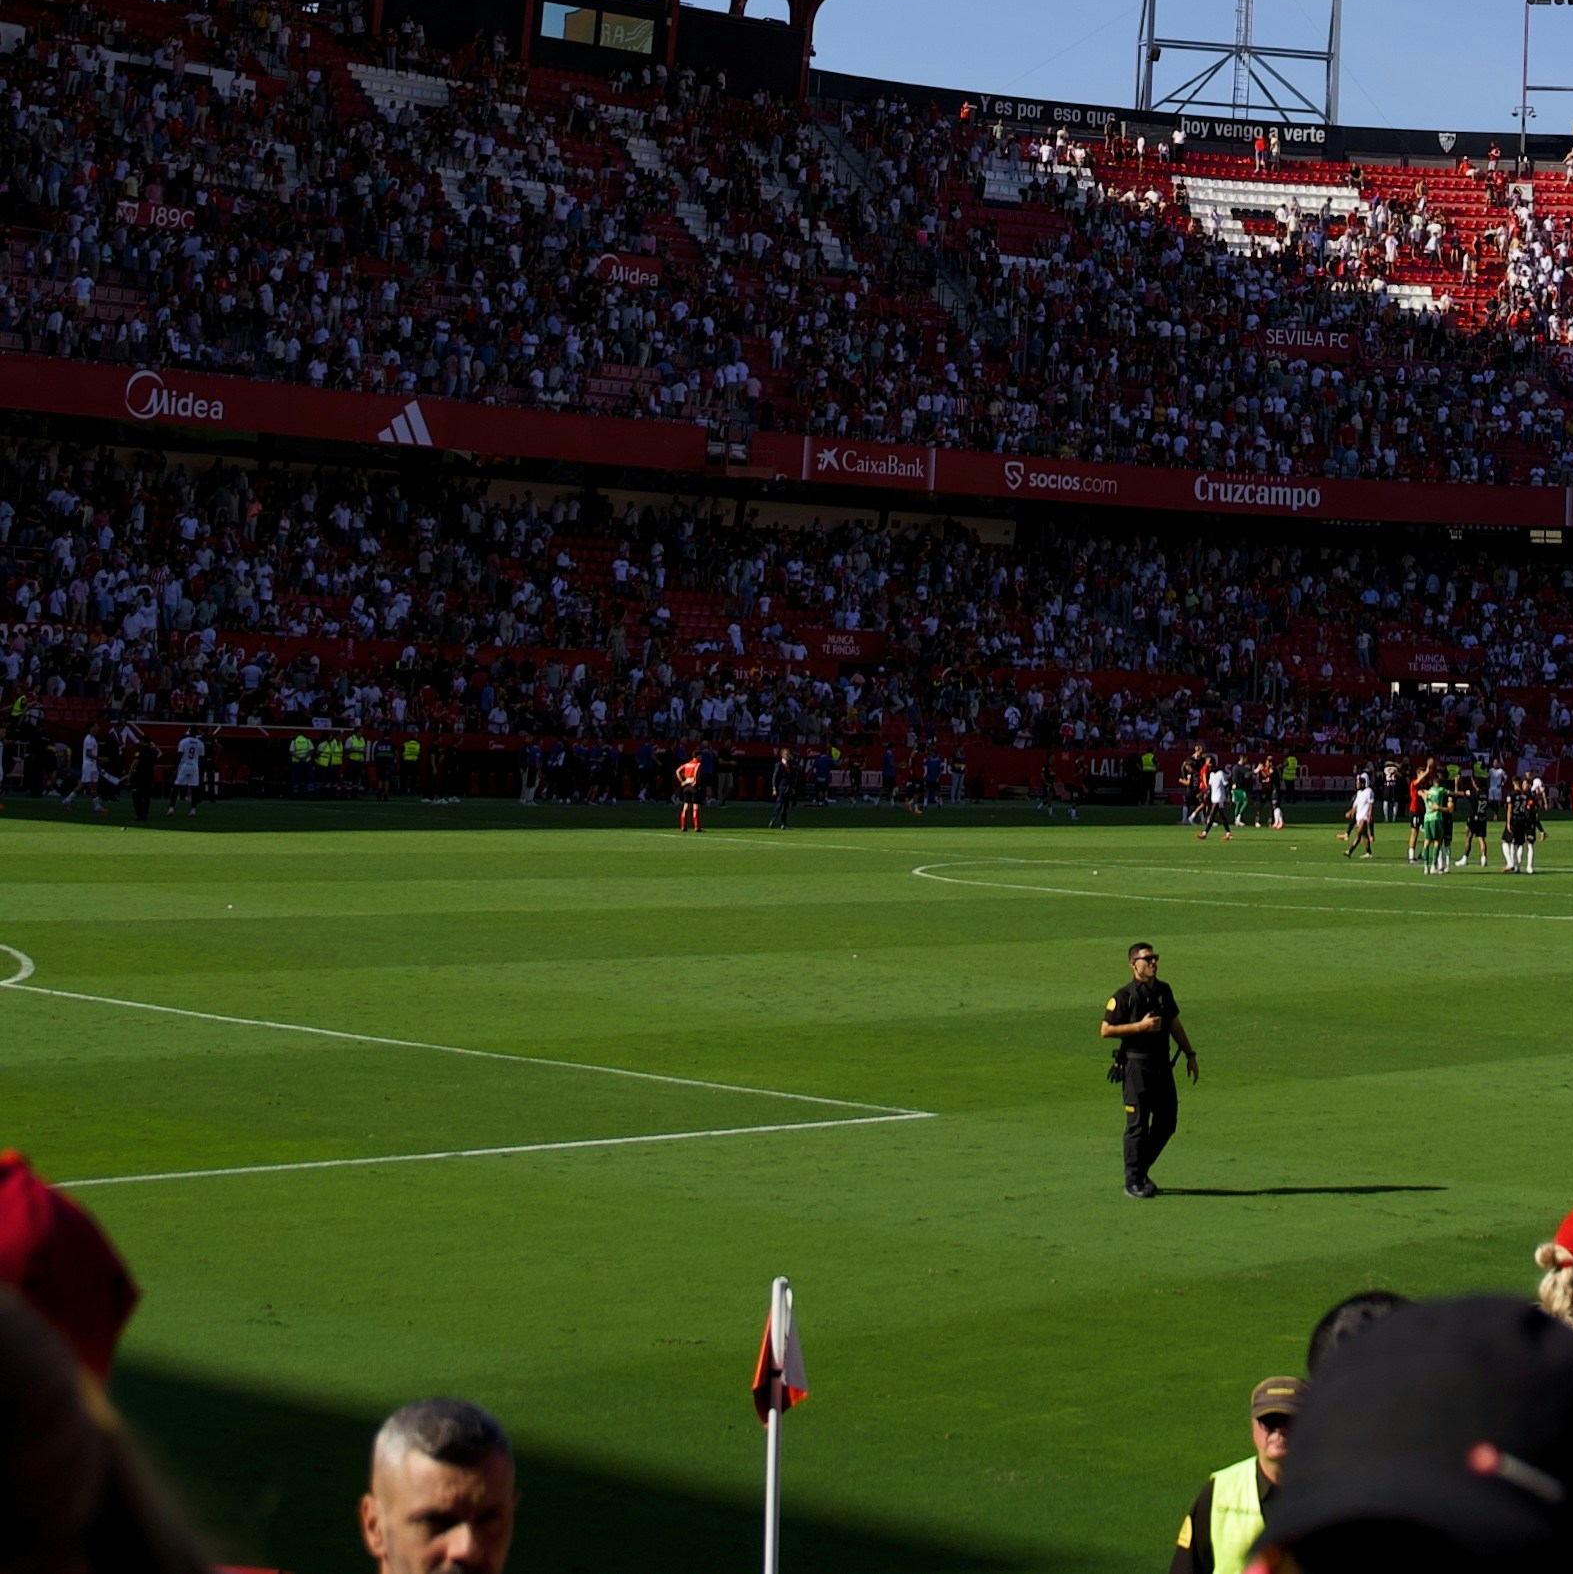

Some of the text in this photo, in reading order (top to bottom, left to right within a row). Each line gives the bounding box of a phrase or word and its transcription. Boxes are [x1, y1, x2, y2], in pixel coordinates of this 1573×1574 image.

[979, 96, 994, 114] Y
[995, 102, 1013, 116] es
[1017, 103, 1045, 121] por
[1053, 107, 1082, 124] eso
[1181, 116, 1326, 144] hoy vengo a verte
[1265, 328, 1350, 349] SEVILLA FC
[136, 387, 225, 421] Midea
[842, 451, 925, 479] CaixaBank
[1028, 472, 1118, 495] socios.com
[1194, 473, 1322, 512] Cruzcampo
[828, 633, 854, 645] NUNCA
[1415, 653, 1446, 664] NUNCA
